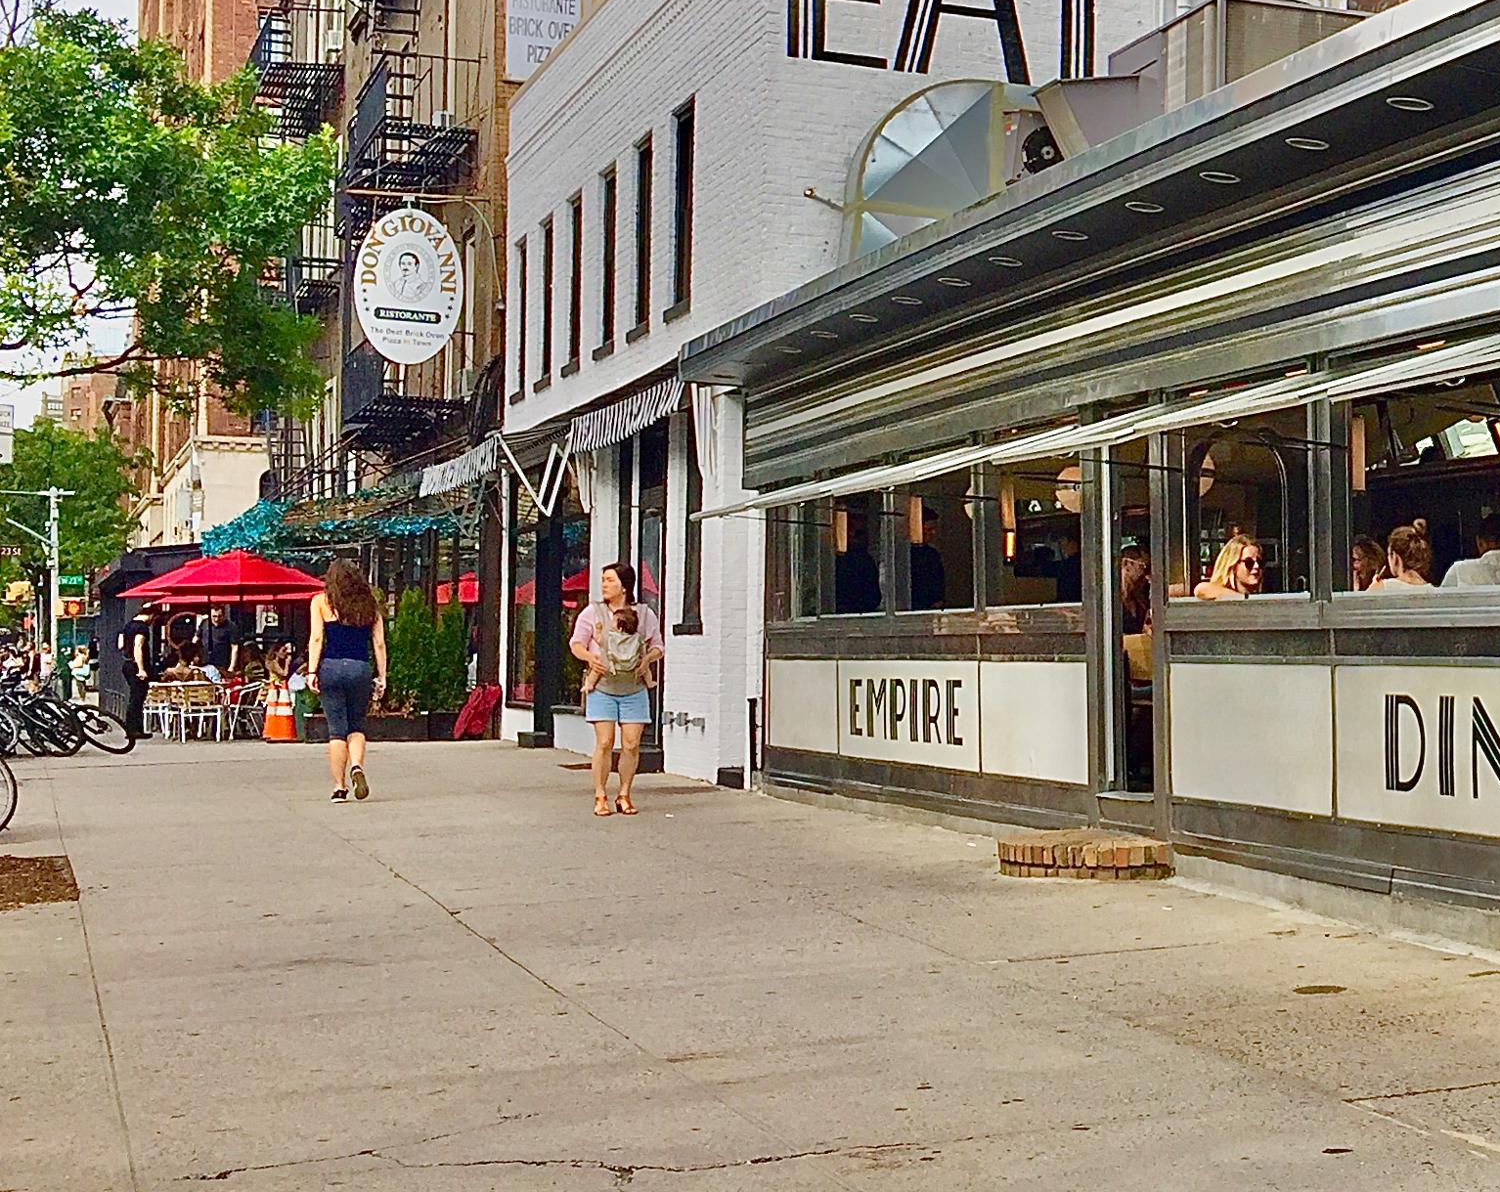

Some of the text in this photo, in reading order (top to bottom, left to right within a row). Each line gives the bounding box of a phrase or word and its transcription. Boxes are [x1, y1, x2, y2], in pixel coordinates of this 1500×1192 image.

[508, 15, 575, 40] BRICK OVE
[360, 232, 385, 286] DON
[381, 214, 457, 294] GIOVANNI
[379, 309, 437, 322] RISTORANTE
[849, 678, 963, 746] EMPIRE
